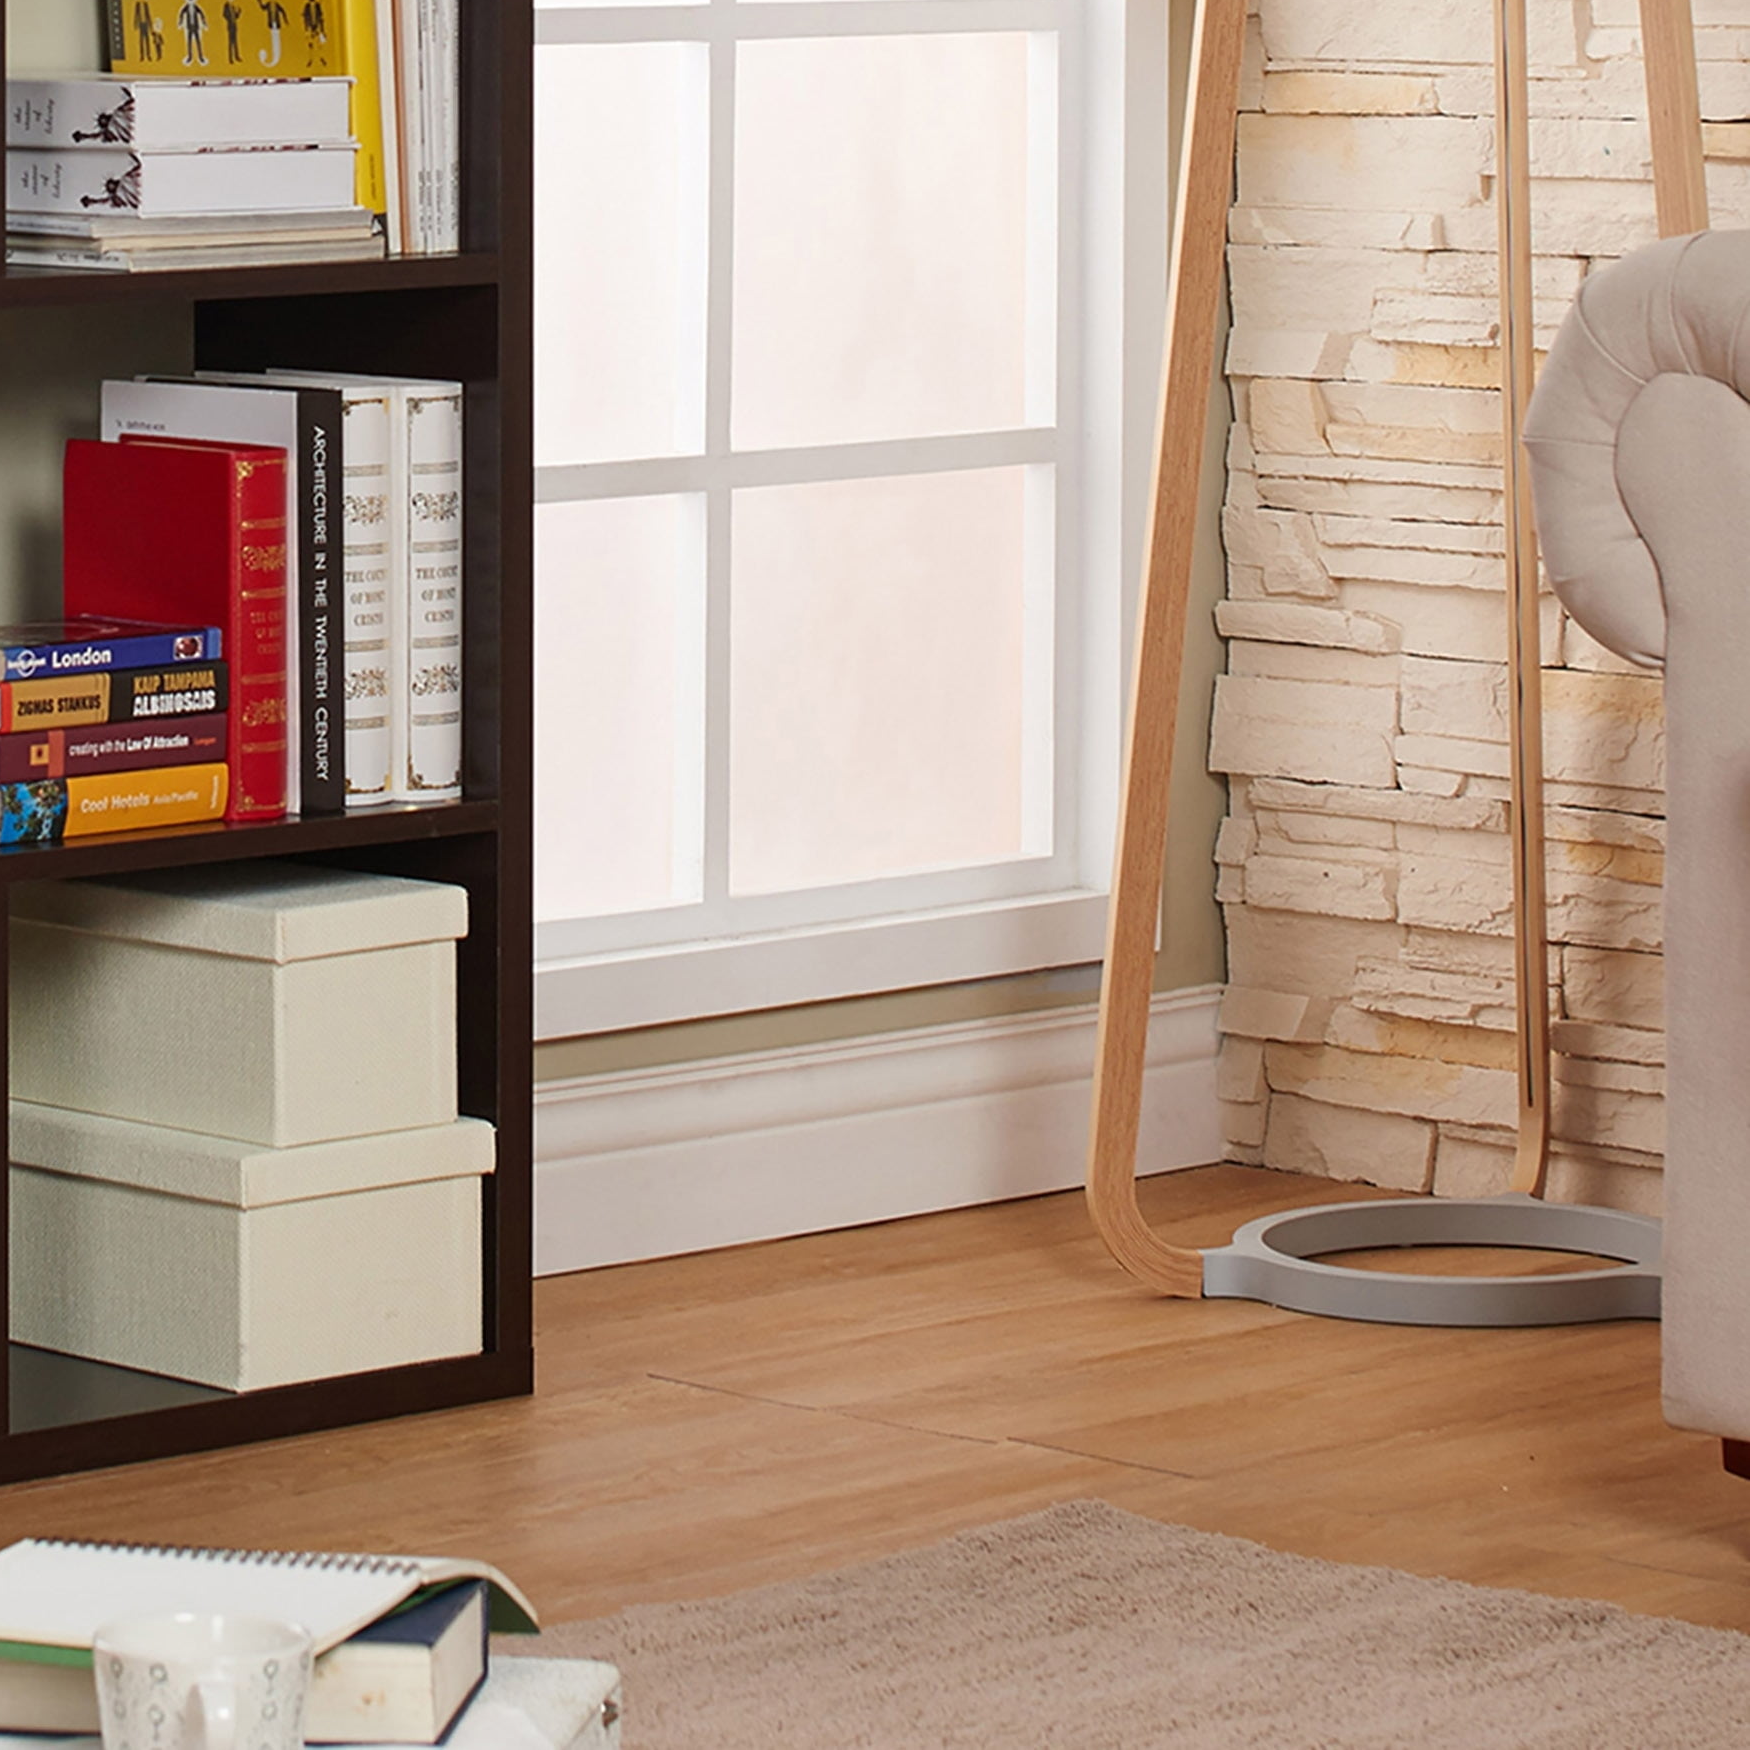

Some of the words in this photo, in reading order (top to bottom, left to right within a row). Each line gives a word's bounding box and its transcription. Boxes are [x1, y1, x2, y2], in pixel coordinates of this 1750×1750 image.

[313, 425, 328, 545] ARCHITECTURE
[314, 551, 327, 571] IN
[314, 578, 327, 607] THE
[52, 645, 112, 669] London
[314, 615, 328, 699] TWENTIETH
[133, 674, 161, 694] KAIP
[17, 698, 54, 716] ZIGMAS
[57, 694, 101, 712] STANKUS
[133, 689, 216, 717] ALBINOSAIS
[68, 742, 99, 757] creating
[99, 740, 113, 753] with
[114, 739, 125, 752] the
[126, 738, 142, 751] Law
[152, 734, 190, 749] Attraction
[315, 706, 330, 781] CENTURY
[80, 796, 108, 813] Cool
[111, 792, 150, 810] Hotels
